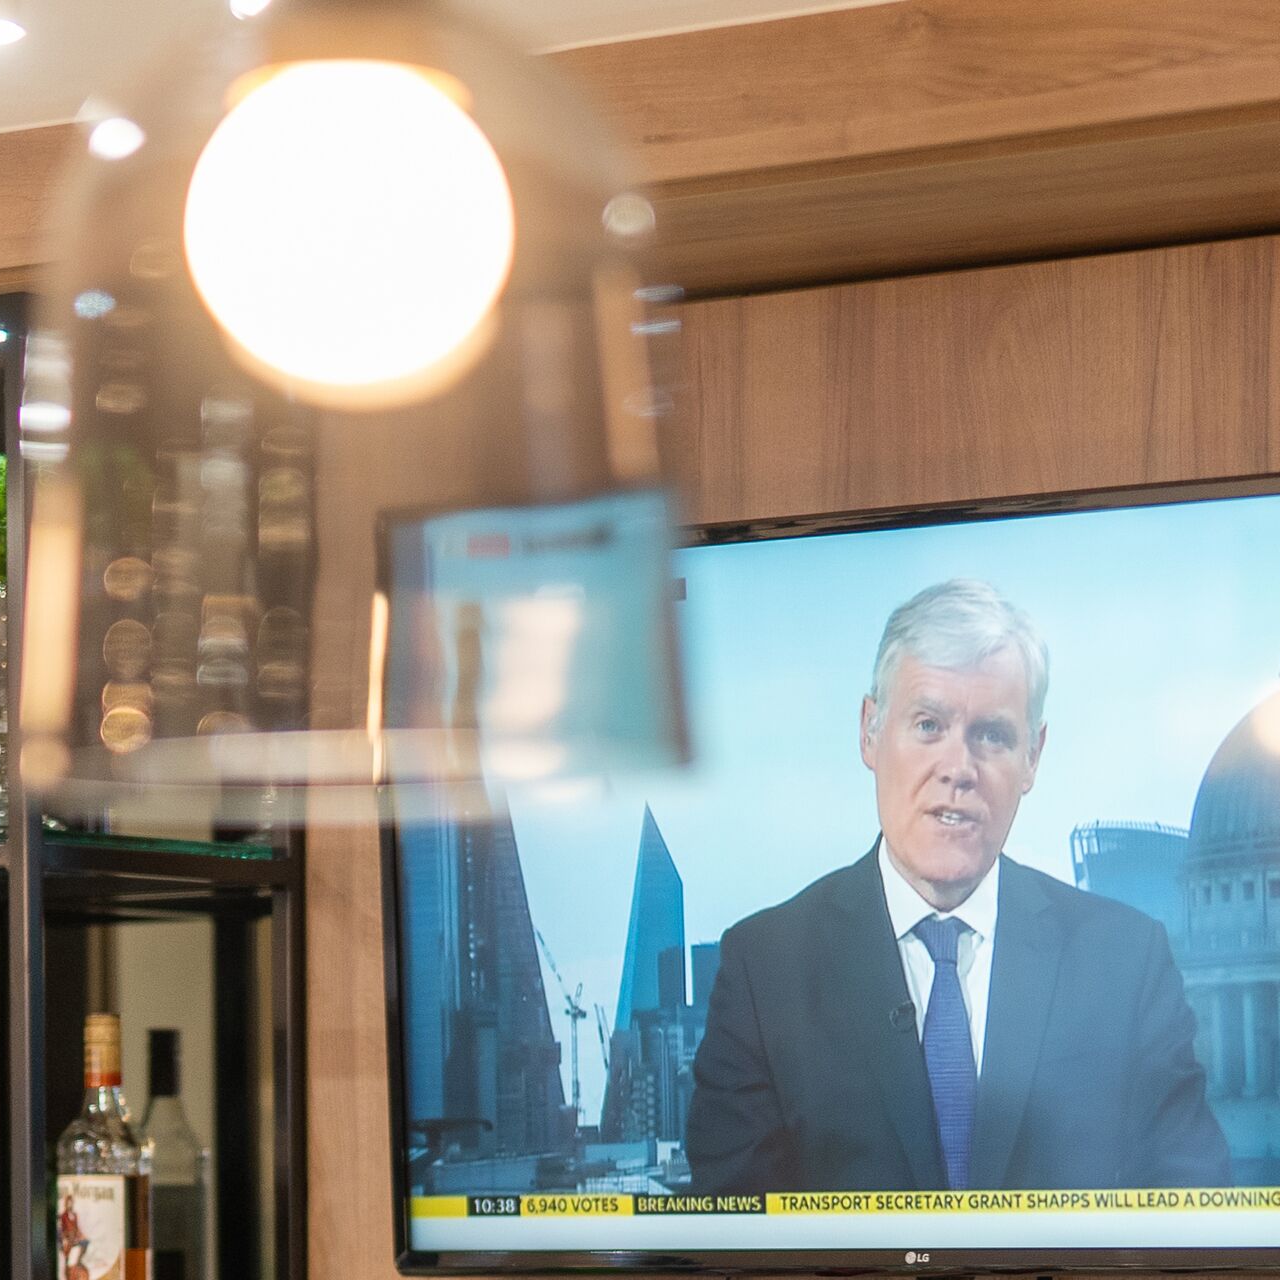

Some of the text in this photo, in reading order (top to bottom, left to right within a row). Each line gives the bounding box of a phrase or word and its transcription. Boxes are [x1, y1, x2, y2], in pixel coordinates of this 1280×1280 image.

[474, 1197, 515, 1214] 10:38
[526, 1195, 619, 1215] 6,940 VOTES
[637, 1195, 761, 1213] BREAKING NEWS
[780, 1194, 871, 1212] TRANSPORT
[876, 1193, 964, 1211] SECRETARY
[968, 1193, 1028, 1210] GRANT
[1028, 1192, 1090, 1209] SHAPPS
[1094, 1192, 1141, 1208] WILL
[1146, 1191, 1179, 1208] LEAD
[1183, 1191, 1195, 1207] A
[916, 1253, 930, 1263] LG
